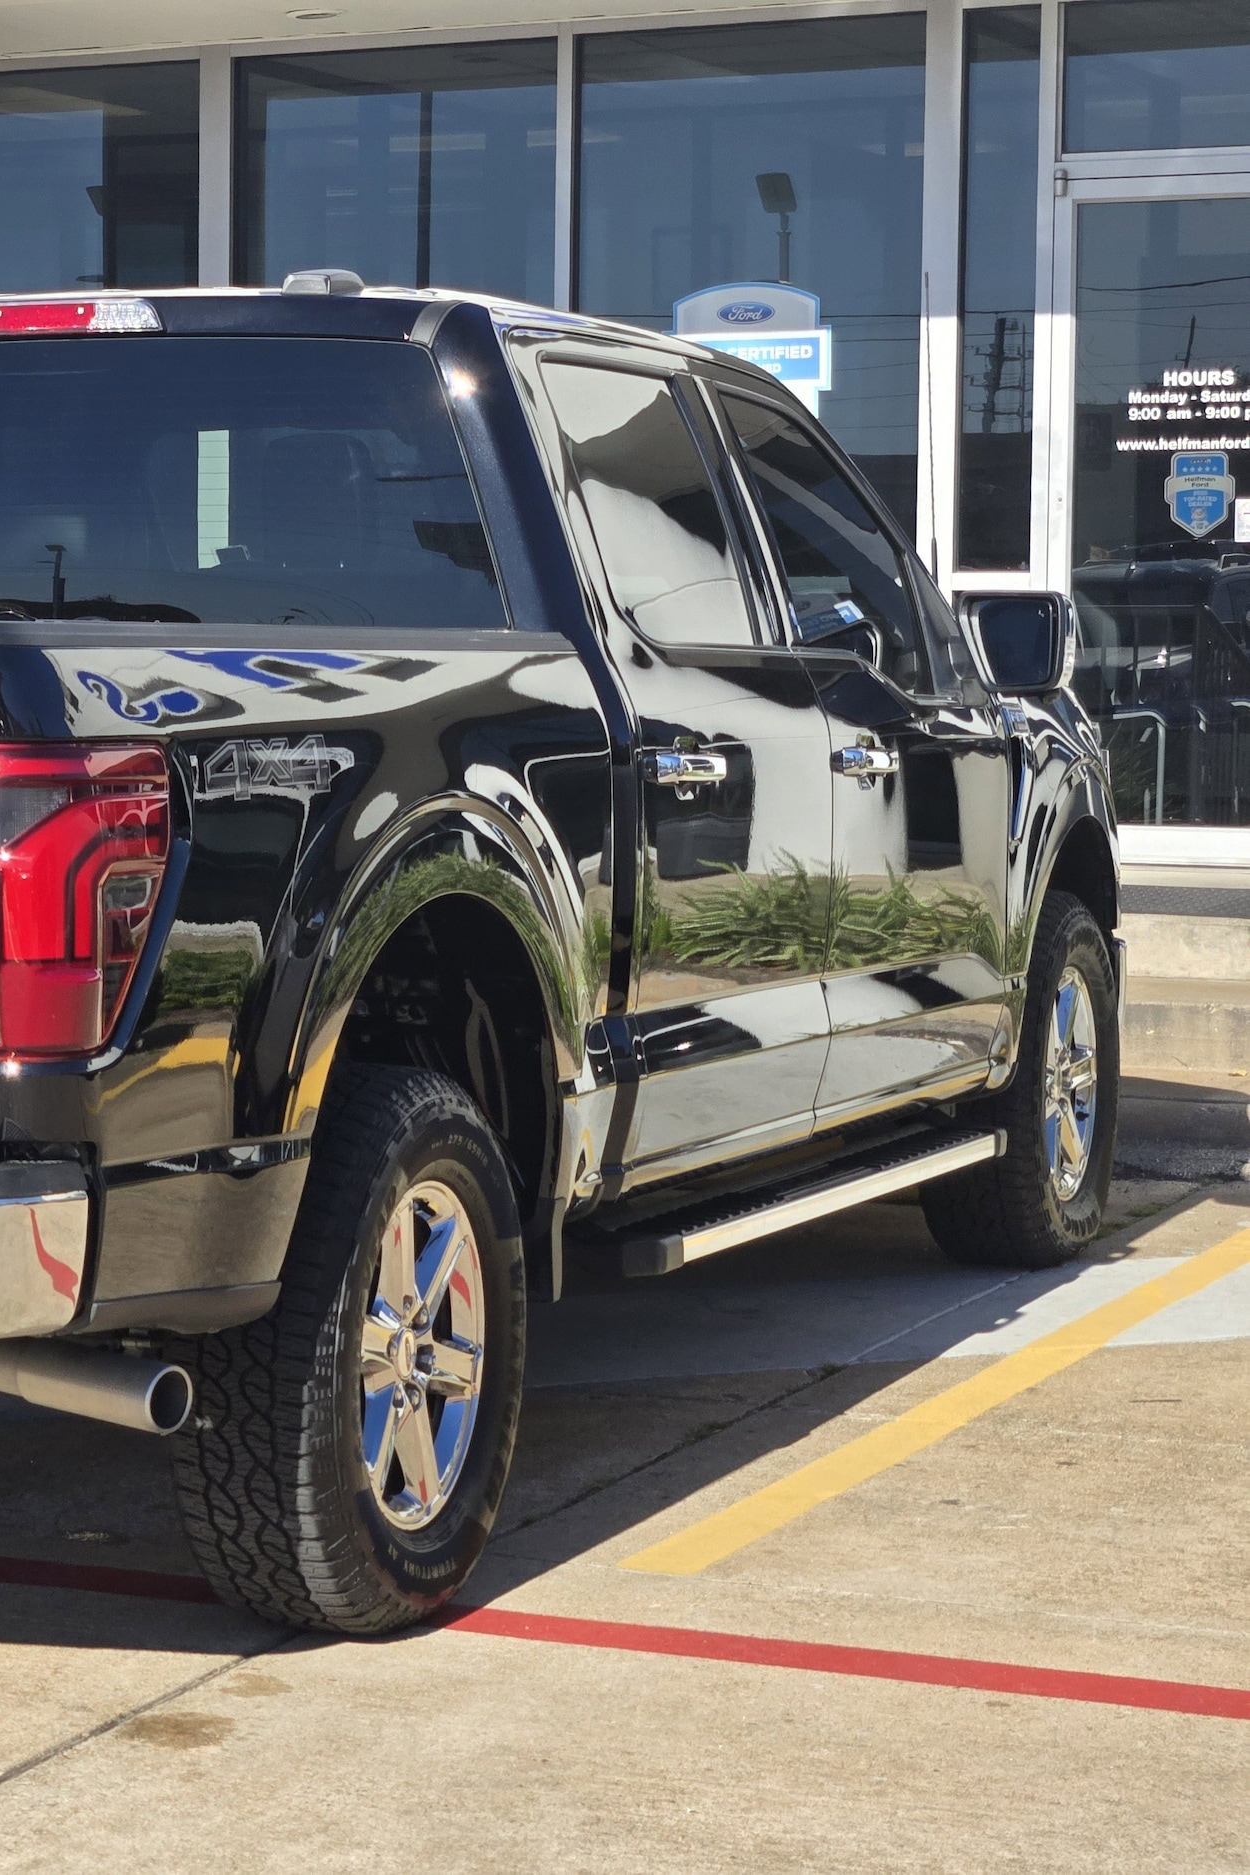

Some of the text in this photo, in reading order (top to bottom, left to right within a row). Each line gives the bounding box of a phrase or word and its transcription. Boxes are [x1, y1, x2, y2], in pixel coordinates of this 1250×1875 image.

[728, 305, 763, 321] Ford
[1163, 370, 1235, 387] HOURS
[1128, 390, 1188, 406] Monday
[1128, 407, 1161, 421] 9:00
[1166, 409, 1191, 420] am
[1205, 406, 1241, 419] 9:00
